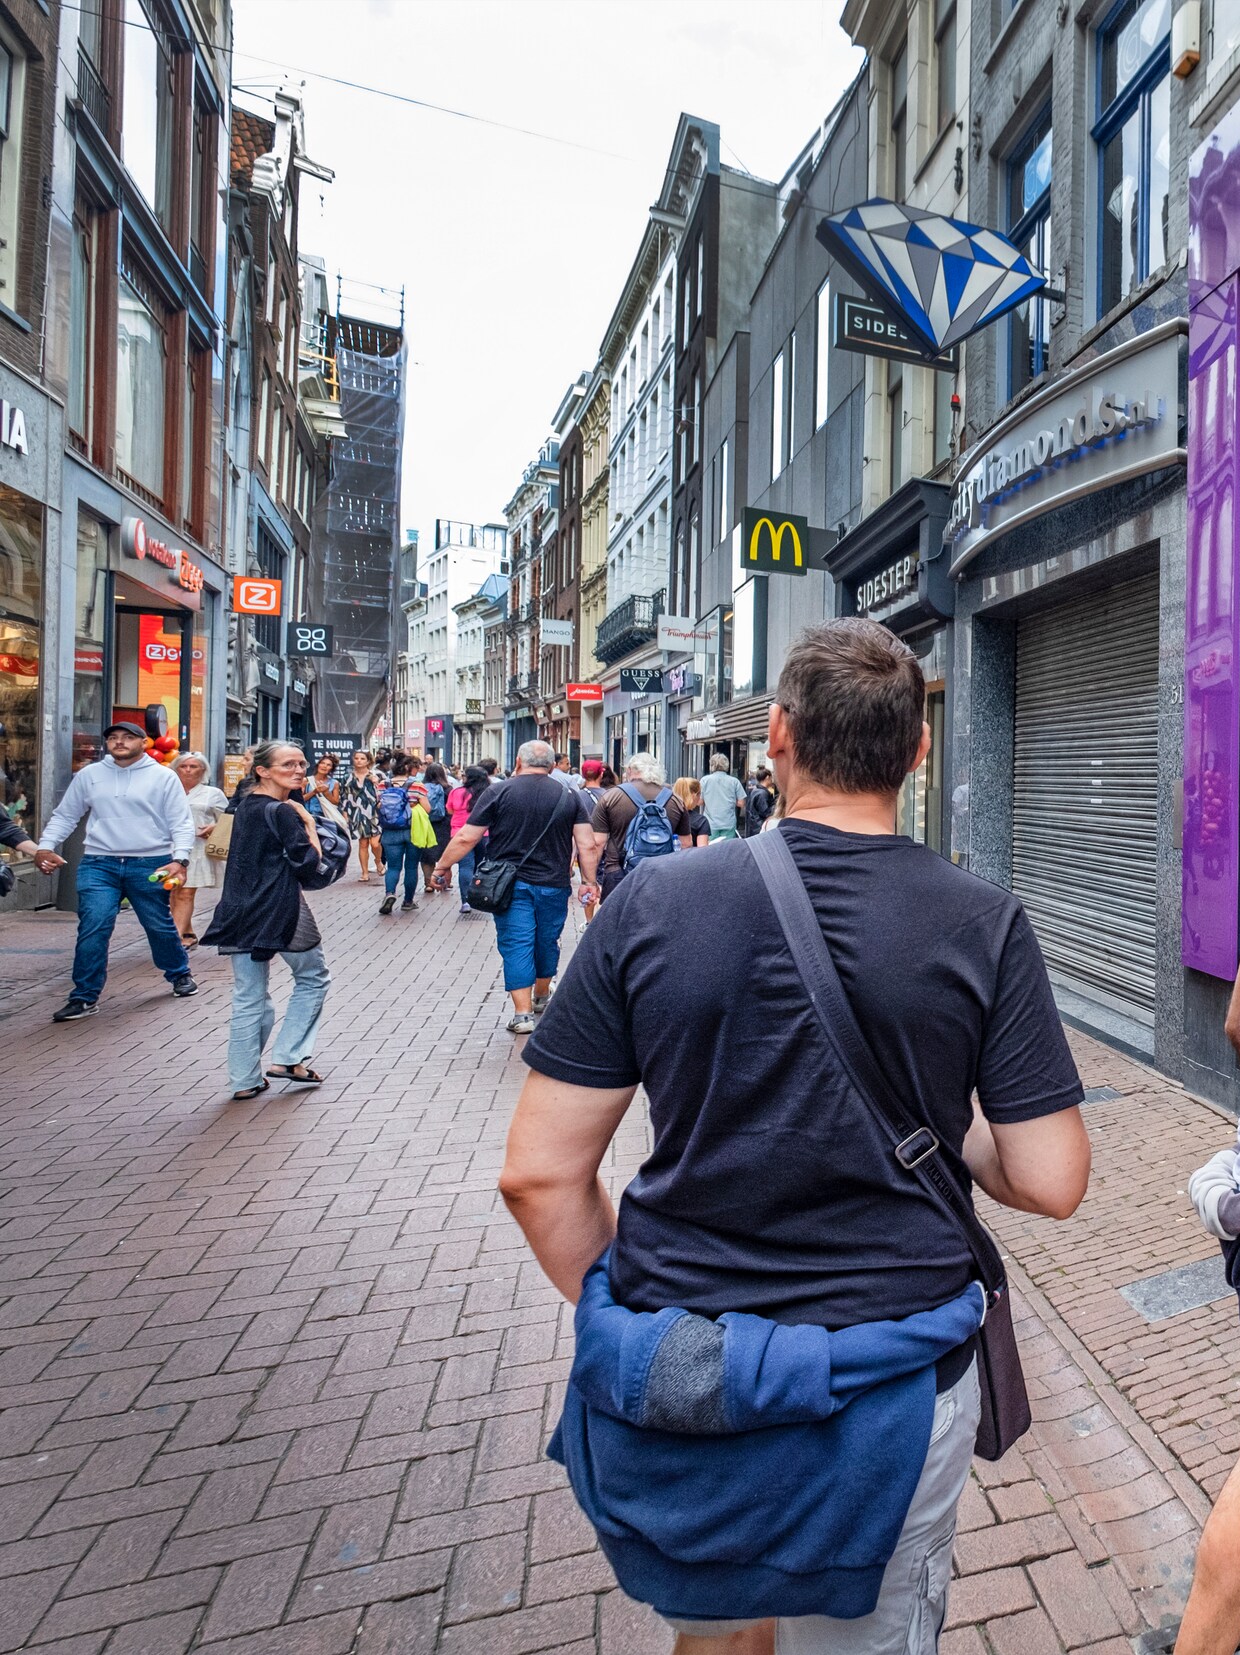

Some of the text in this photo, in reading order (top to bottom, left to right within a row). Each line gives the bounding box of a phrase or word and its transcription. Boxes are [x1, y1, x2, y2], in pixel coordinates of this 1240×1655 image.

[857, 555, 915, 612] SIDESTEP
[543, 628, 571, 637] MANGO
[621, 669, 660, 677] GUESS
[311, 739, 353, 749] TE HUUR
